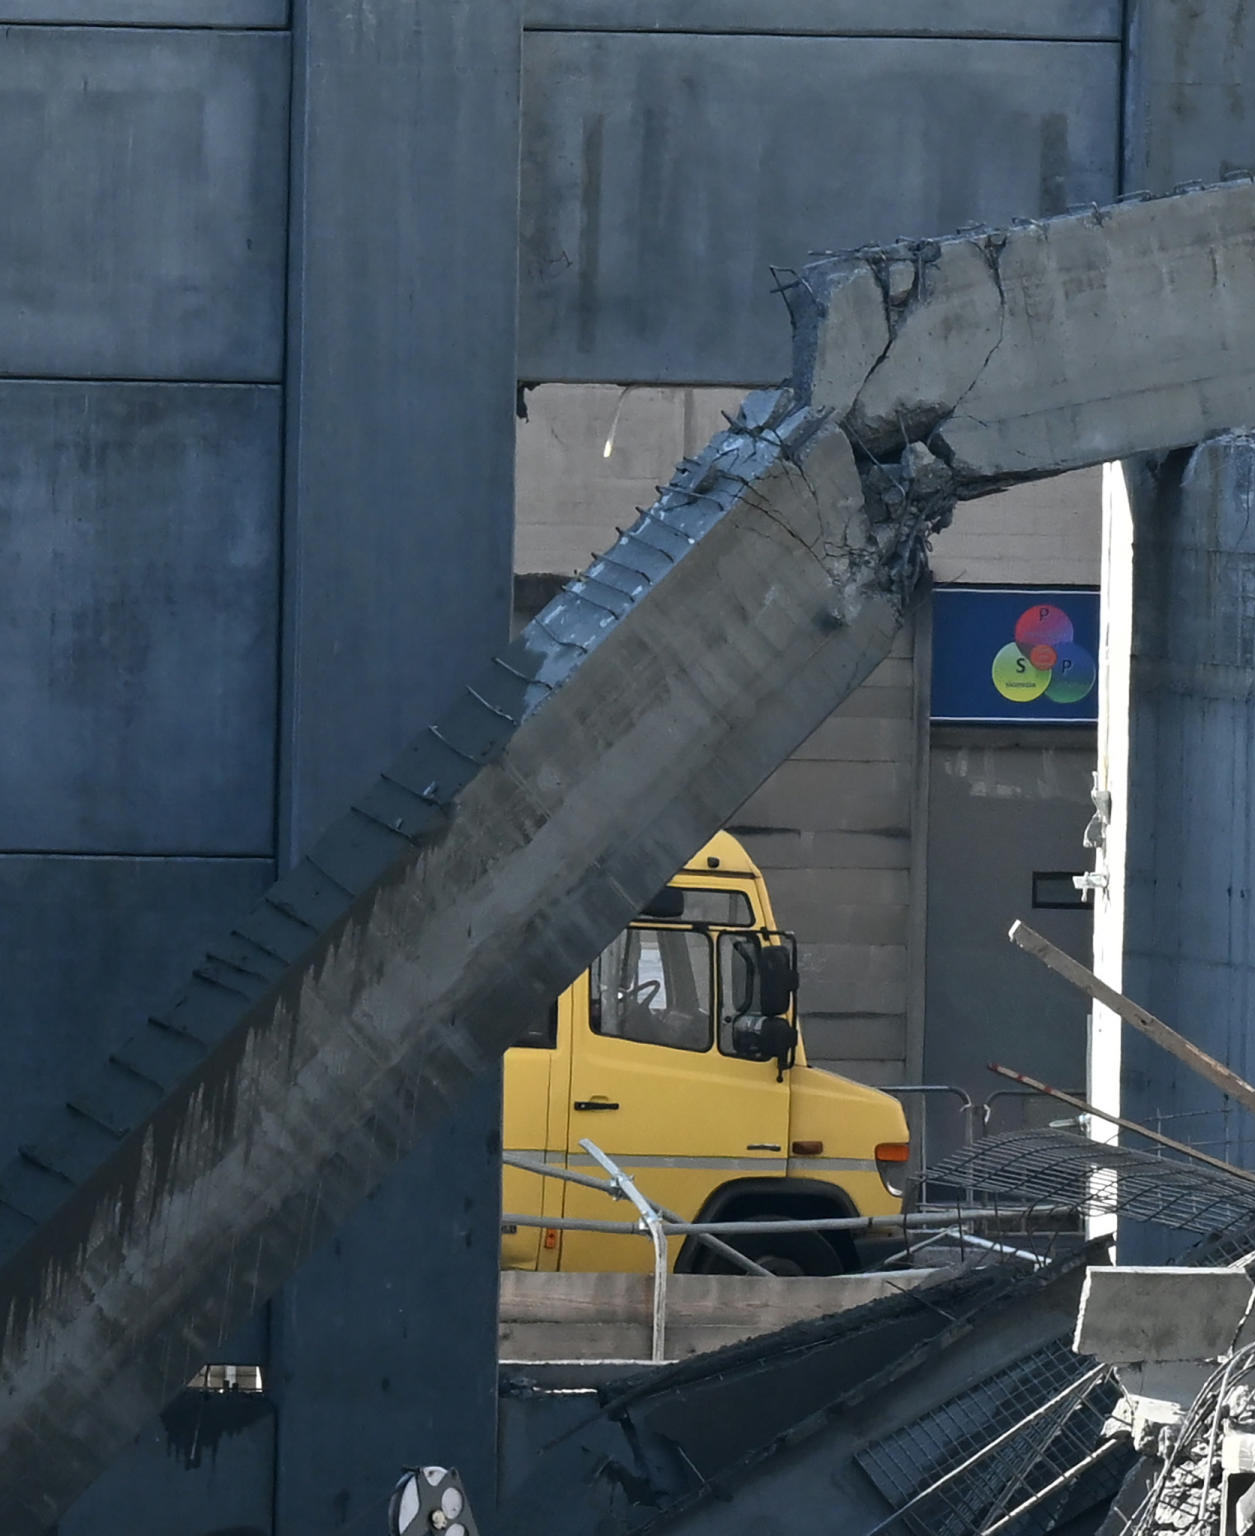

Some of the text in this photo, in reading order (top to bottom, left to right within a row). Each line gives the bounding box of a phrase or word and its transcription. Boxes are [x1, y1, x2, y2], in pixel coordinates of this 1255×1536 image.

[1039, 608, 1049, 621] P
[1016, 658, 1026, 673] S
[1062, 659, 1072, 673] P
